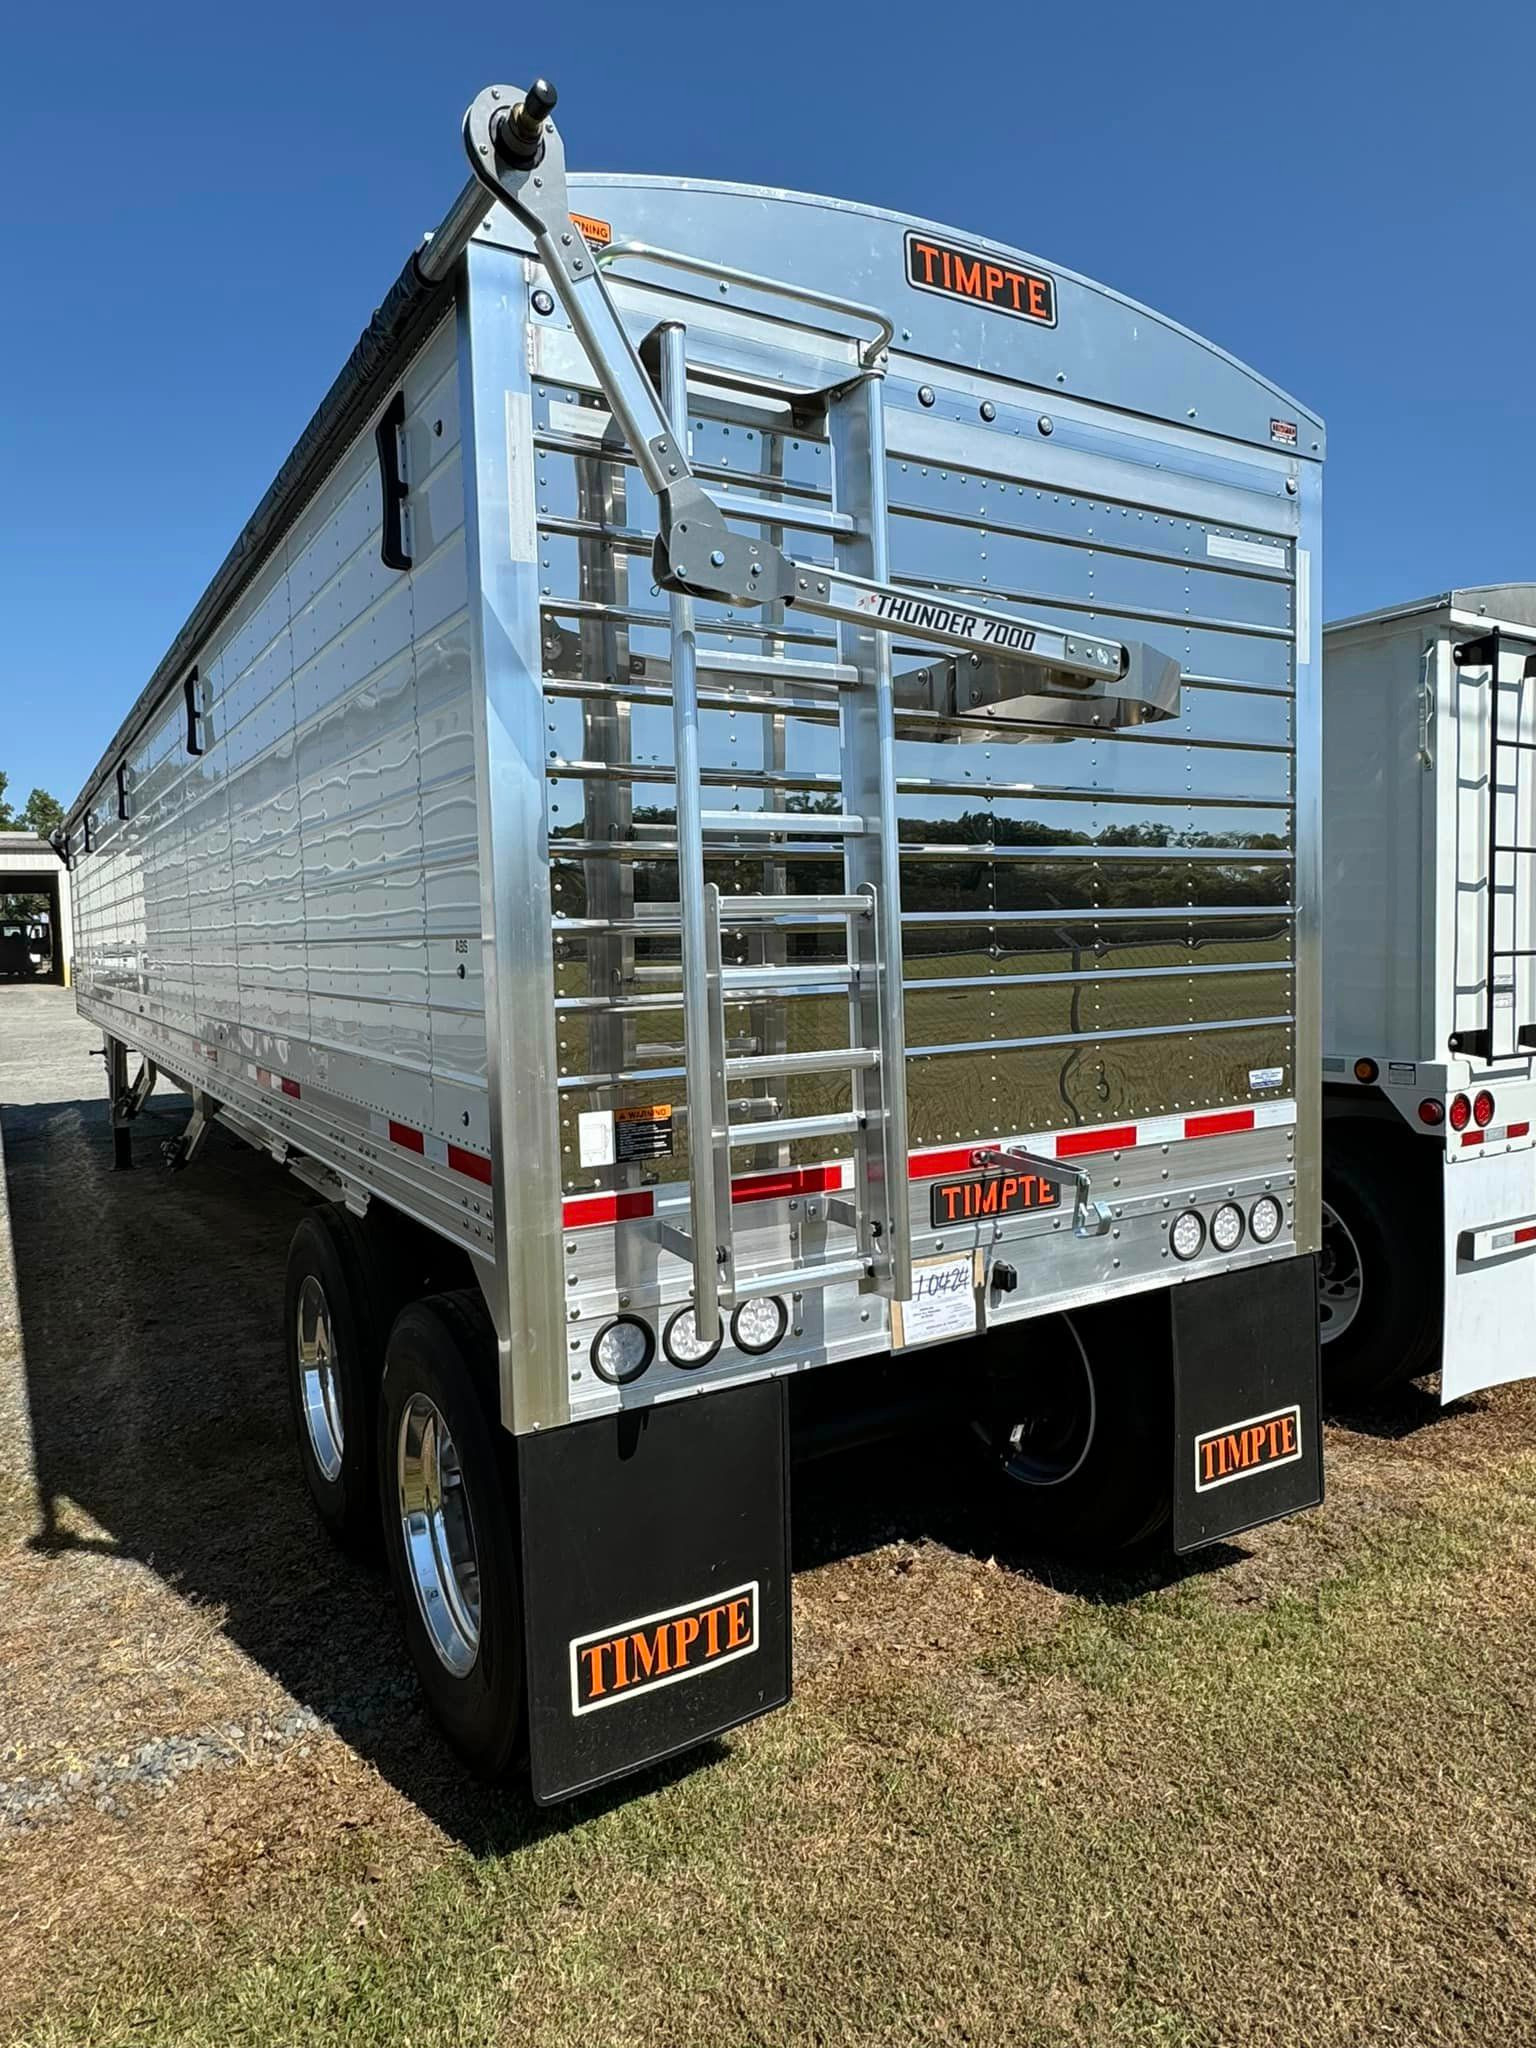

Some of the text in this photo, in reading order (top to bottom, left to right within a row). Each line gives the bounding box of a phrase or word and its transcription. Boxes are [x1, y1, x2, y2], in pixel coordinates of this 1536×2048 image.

[574, 220, 608, 239] NING
[916, 243, 1047, 317] TIMPTE
[877, 594, 1036, 651] THUNDER 7000
[455, 939, 468, 953] ABS
[941, 1175, 1055, 1219] TIMPTE
[1201, 1416, 1296, 1480] TIMPTE
[581, 1597, 751, 1698] TIMPTE
